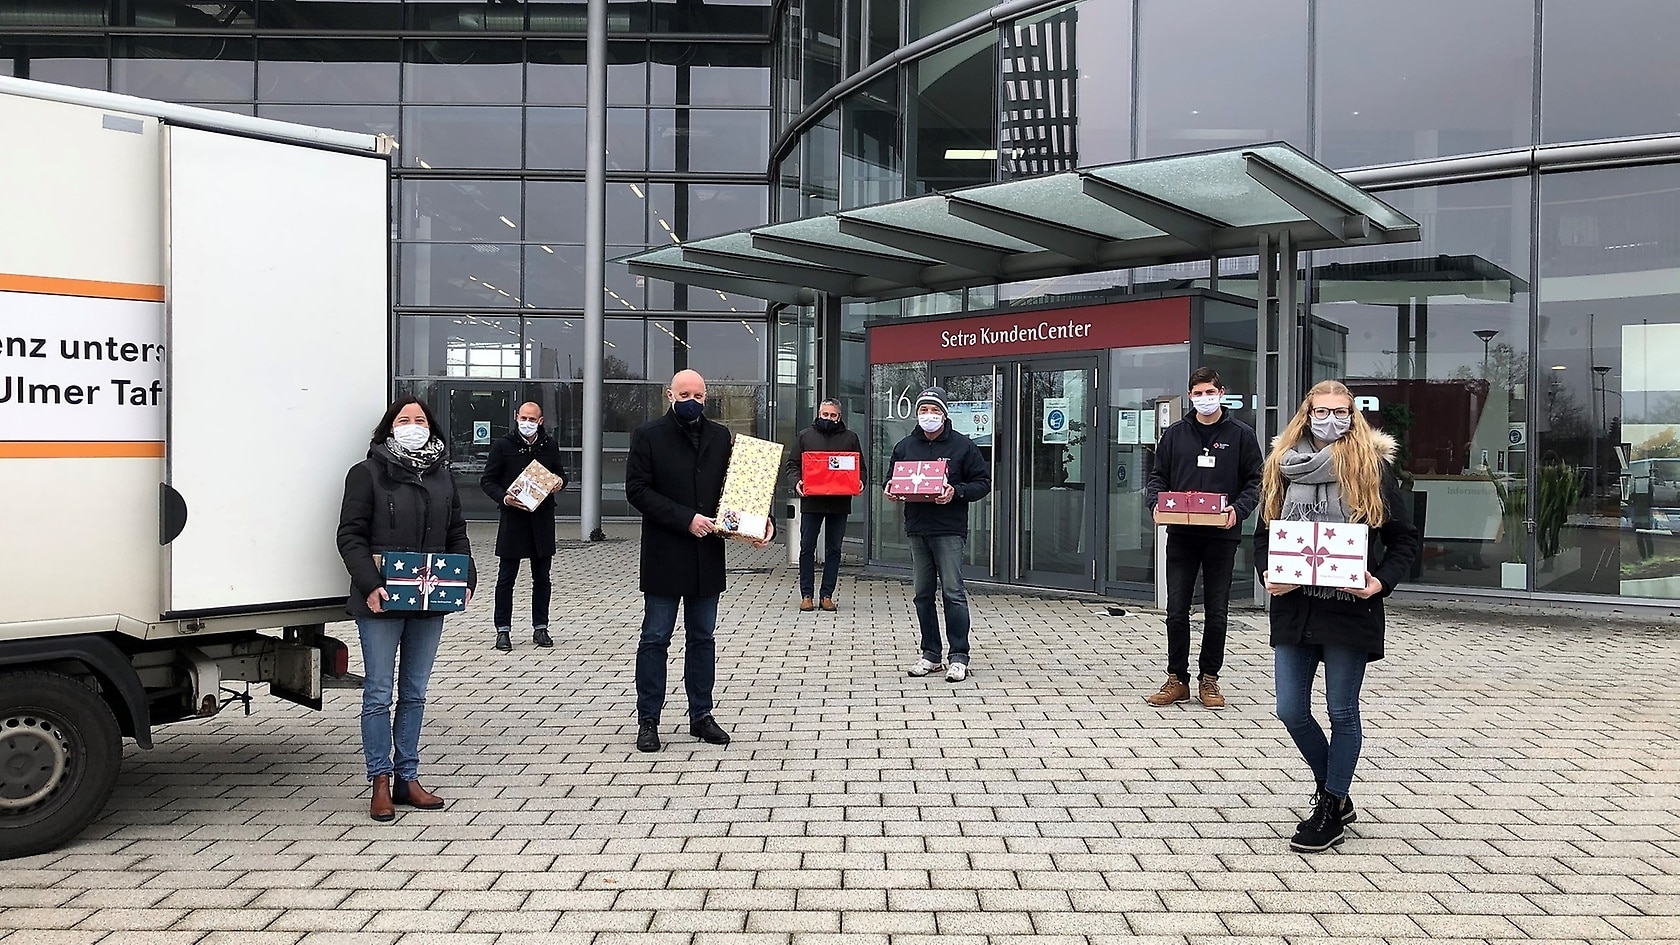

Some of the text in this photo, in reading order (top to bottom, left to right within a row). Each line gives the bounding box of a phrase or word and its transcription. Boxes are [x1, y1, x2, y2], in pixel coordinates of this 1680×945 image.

[0, 336, 47, 359] nz
[941, 319, 1092, 348] Setra KundenCenter
[885, 385, 911, 419] 16
